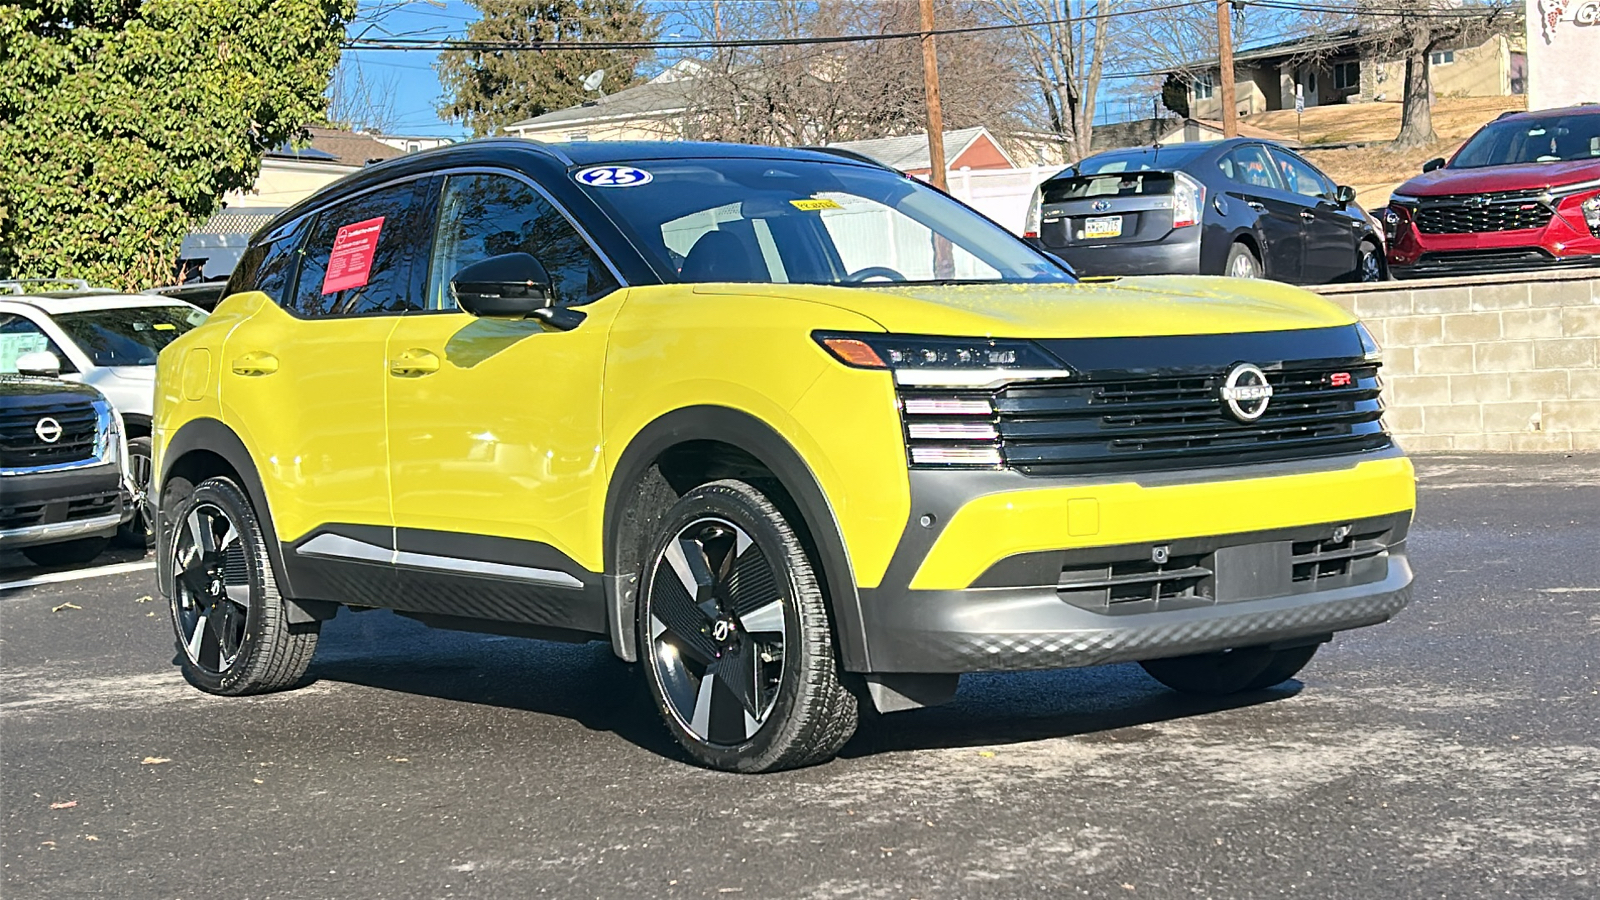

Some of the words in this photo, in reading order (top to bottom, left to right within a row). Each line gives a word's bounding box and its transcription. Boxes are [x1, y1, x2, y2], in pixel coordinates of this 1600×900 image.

[590, 168, 636, 184] 25
[1331, 373, 1351, 386] SR
[1225, 385, 1271, 400] NISSAN
